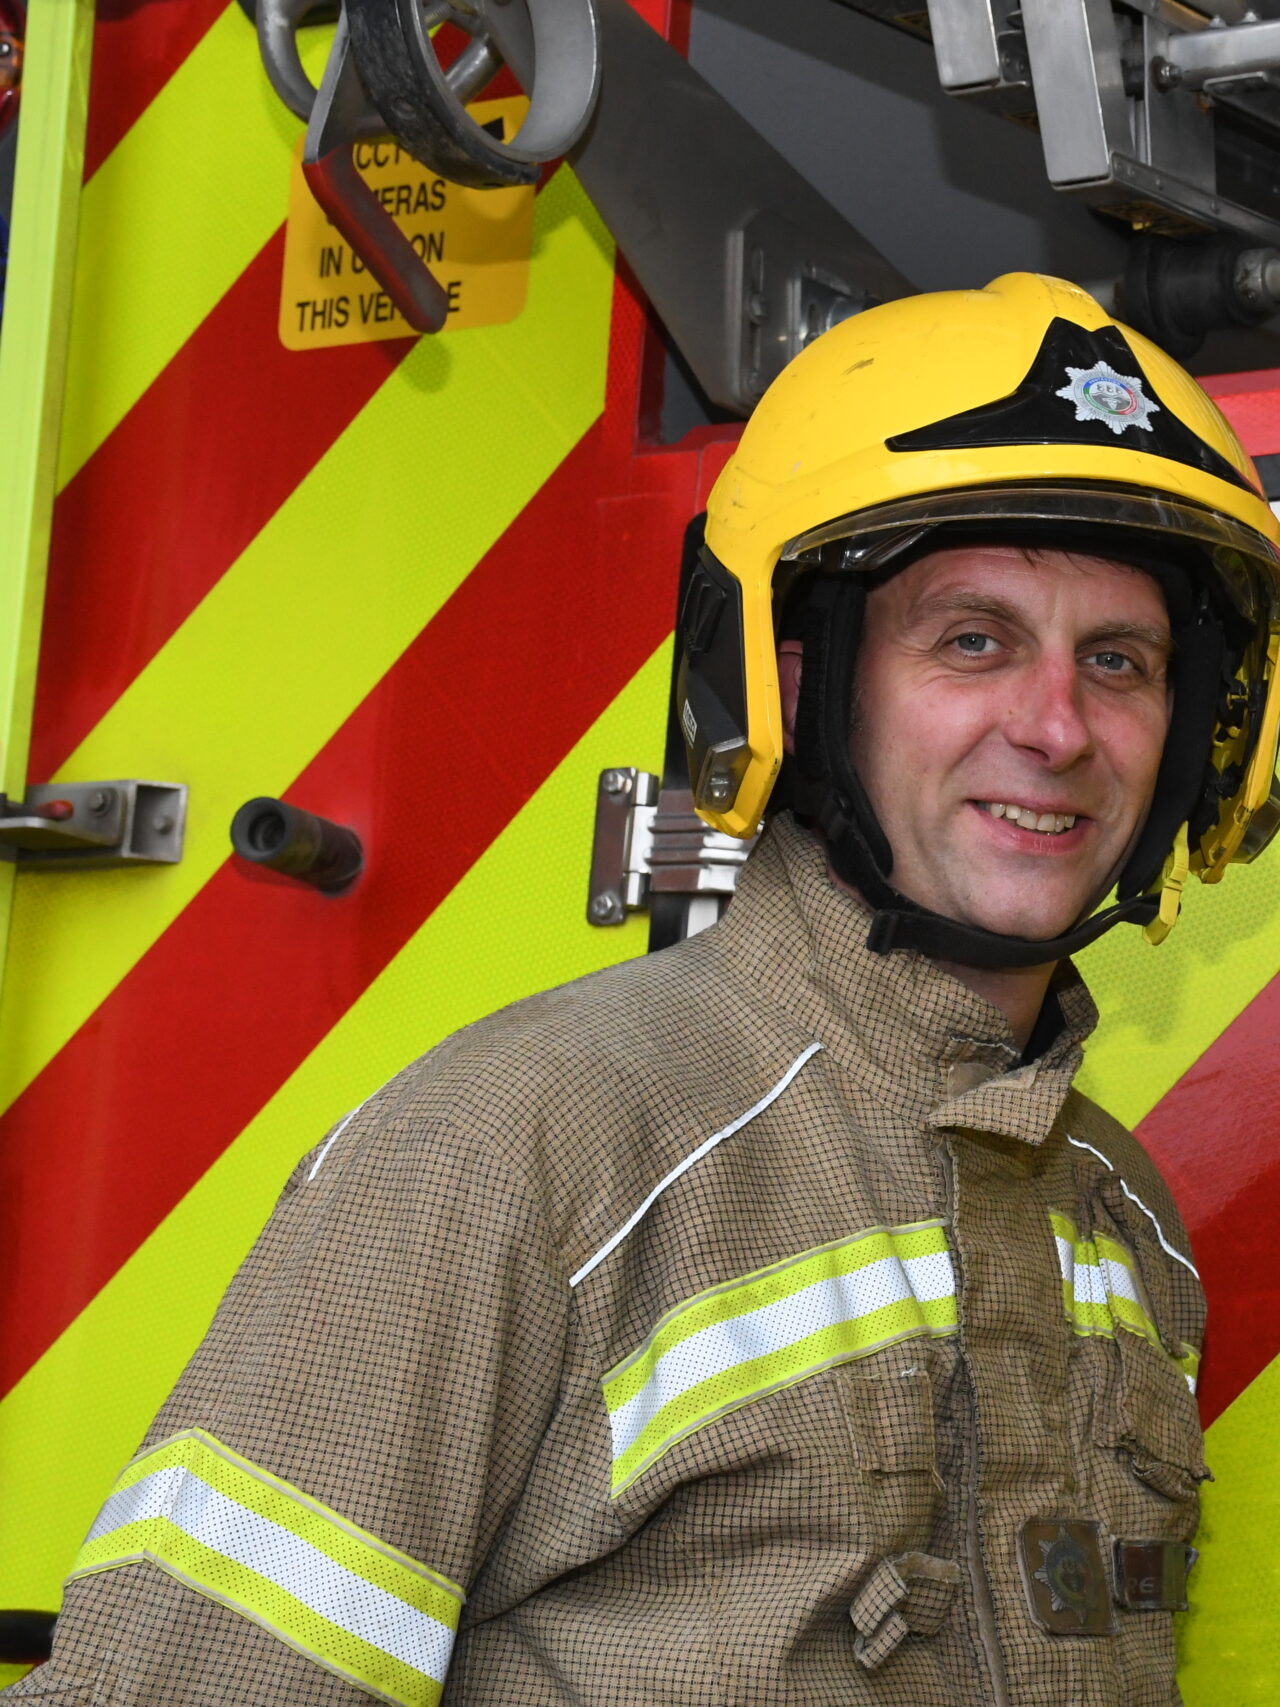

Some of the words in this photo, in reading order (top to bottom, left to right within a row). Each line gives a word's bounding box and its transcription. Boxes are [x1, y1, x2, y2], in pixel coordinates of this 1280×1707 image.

[357, 141, 418, 170] CCT
[319, 246, 343, 278] IN
[296, 296, 350, 332] THIS
